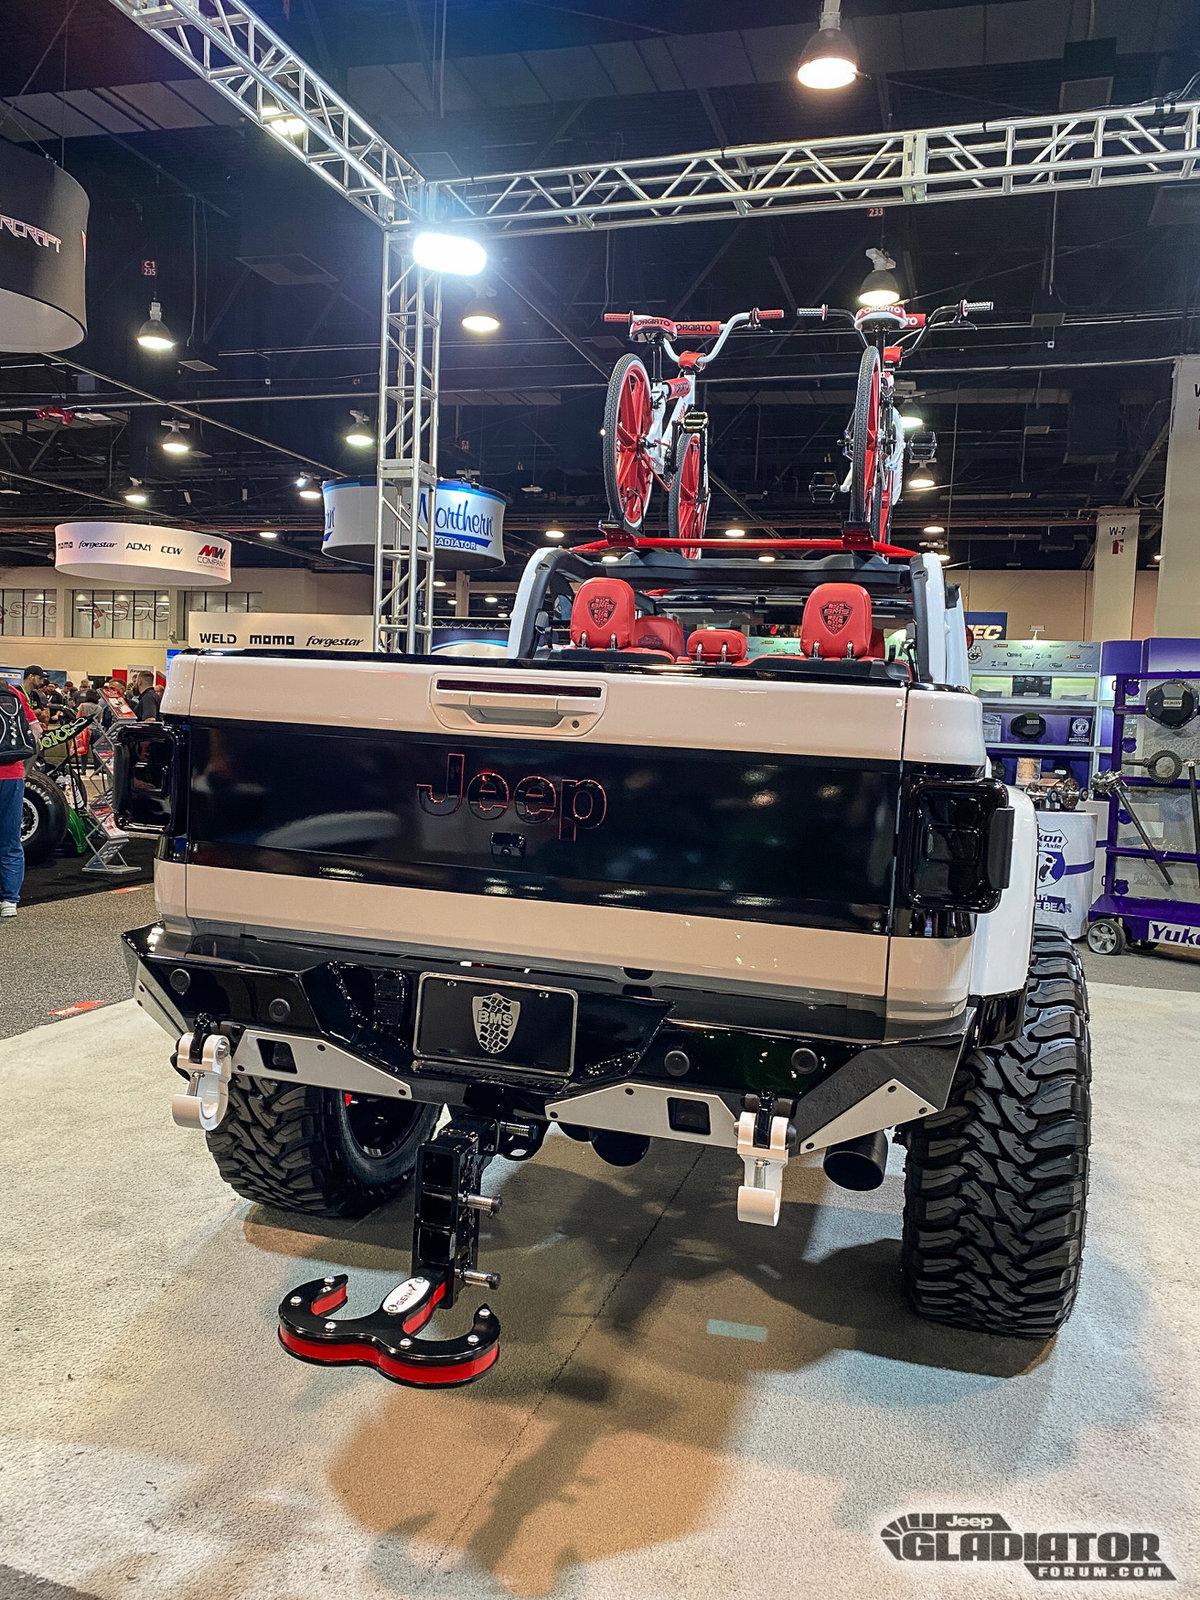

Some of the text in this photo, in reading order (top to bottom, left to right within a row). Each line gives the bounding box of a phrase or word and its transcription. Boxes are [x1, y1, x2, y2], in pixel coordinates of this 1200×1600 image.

[675, 323, 712, 332] ORGIATO
[1109, 527, 1126, 536] W-7
[79, 540, 118, 549] forgestar
[200, 633, 364, 648] WELD momo forgestar
[416, 753, 608, 842] Jeep
[1043, 901, 1072, 913] BEAR
[477, 1009, 513, 1027] BMS
